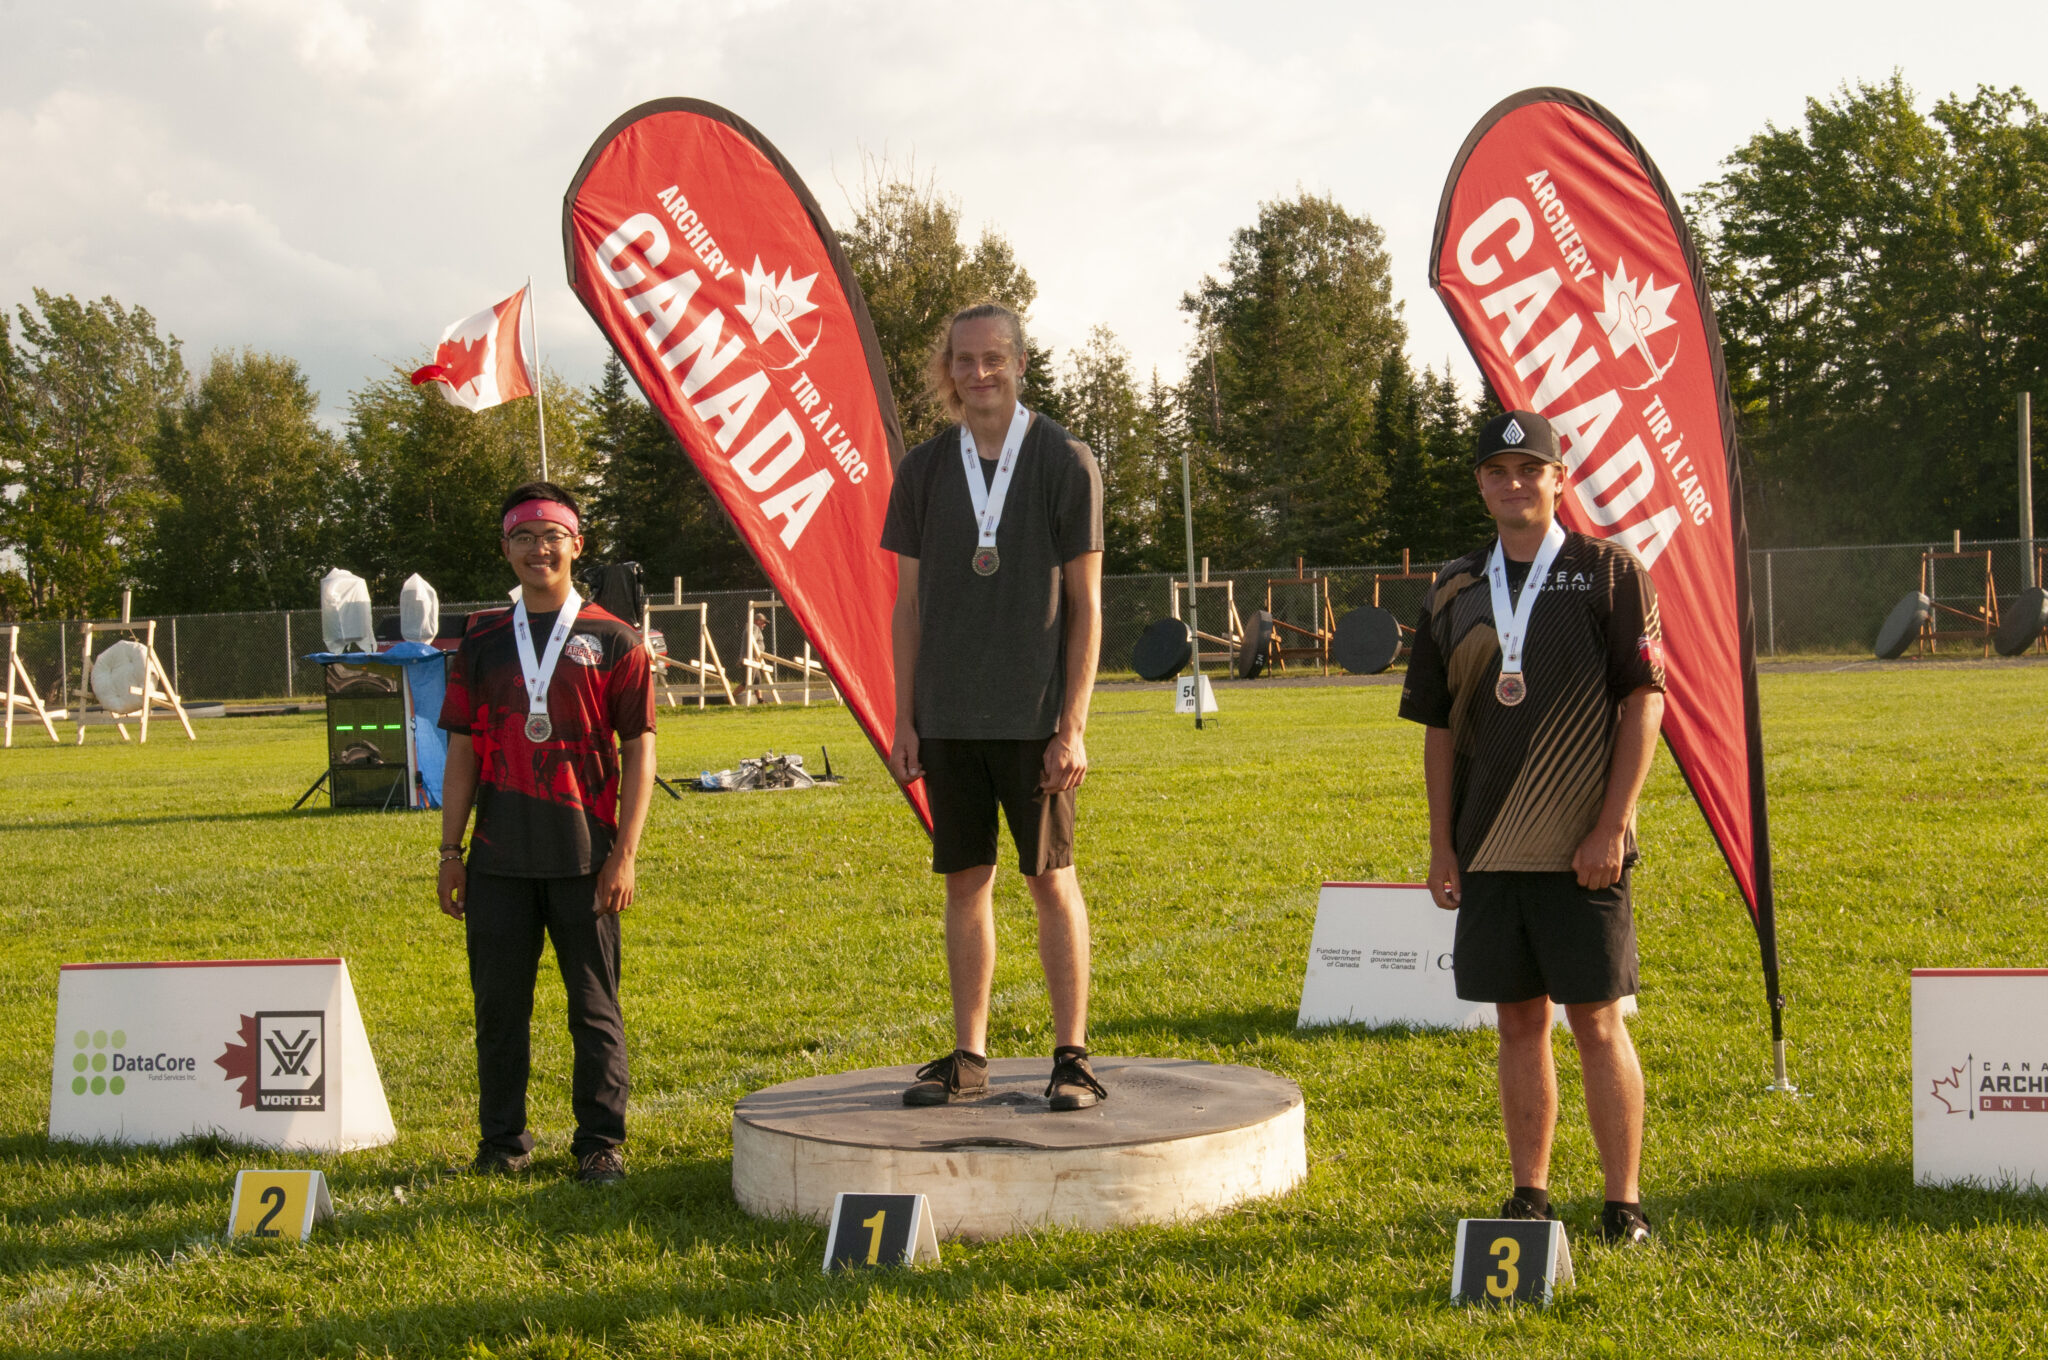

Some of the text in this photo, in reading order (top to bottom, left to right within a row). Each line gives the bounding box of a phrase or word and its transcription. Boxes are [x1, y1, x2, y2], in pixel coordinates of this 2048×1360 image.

[656, 184, 735, 281] ARCHERY
[1525, 169, 1597, 284] ARCHERY
[595, 212, 836, 551] CANADA
[1456, 196, 1682, 573] CANADA
[789, 370, 869, 485] TIR À L'ARC
[1641, 393, 1713, 527] TIR À L'ARC
[1321, 954, 1361, 962] Government
[112, 1053, 196, 1072] DataCore
[148, 1073, 162, 1081] Fund
[163, 1073, 186, 1081] Services
[260, 1094, 322, 1106] VORTEX
[254, 1186, 286, 1238] 2
[862, 1210, 887, 1265] 1
[1485, 1236, 1521, 1298] 3
